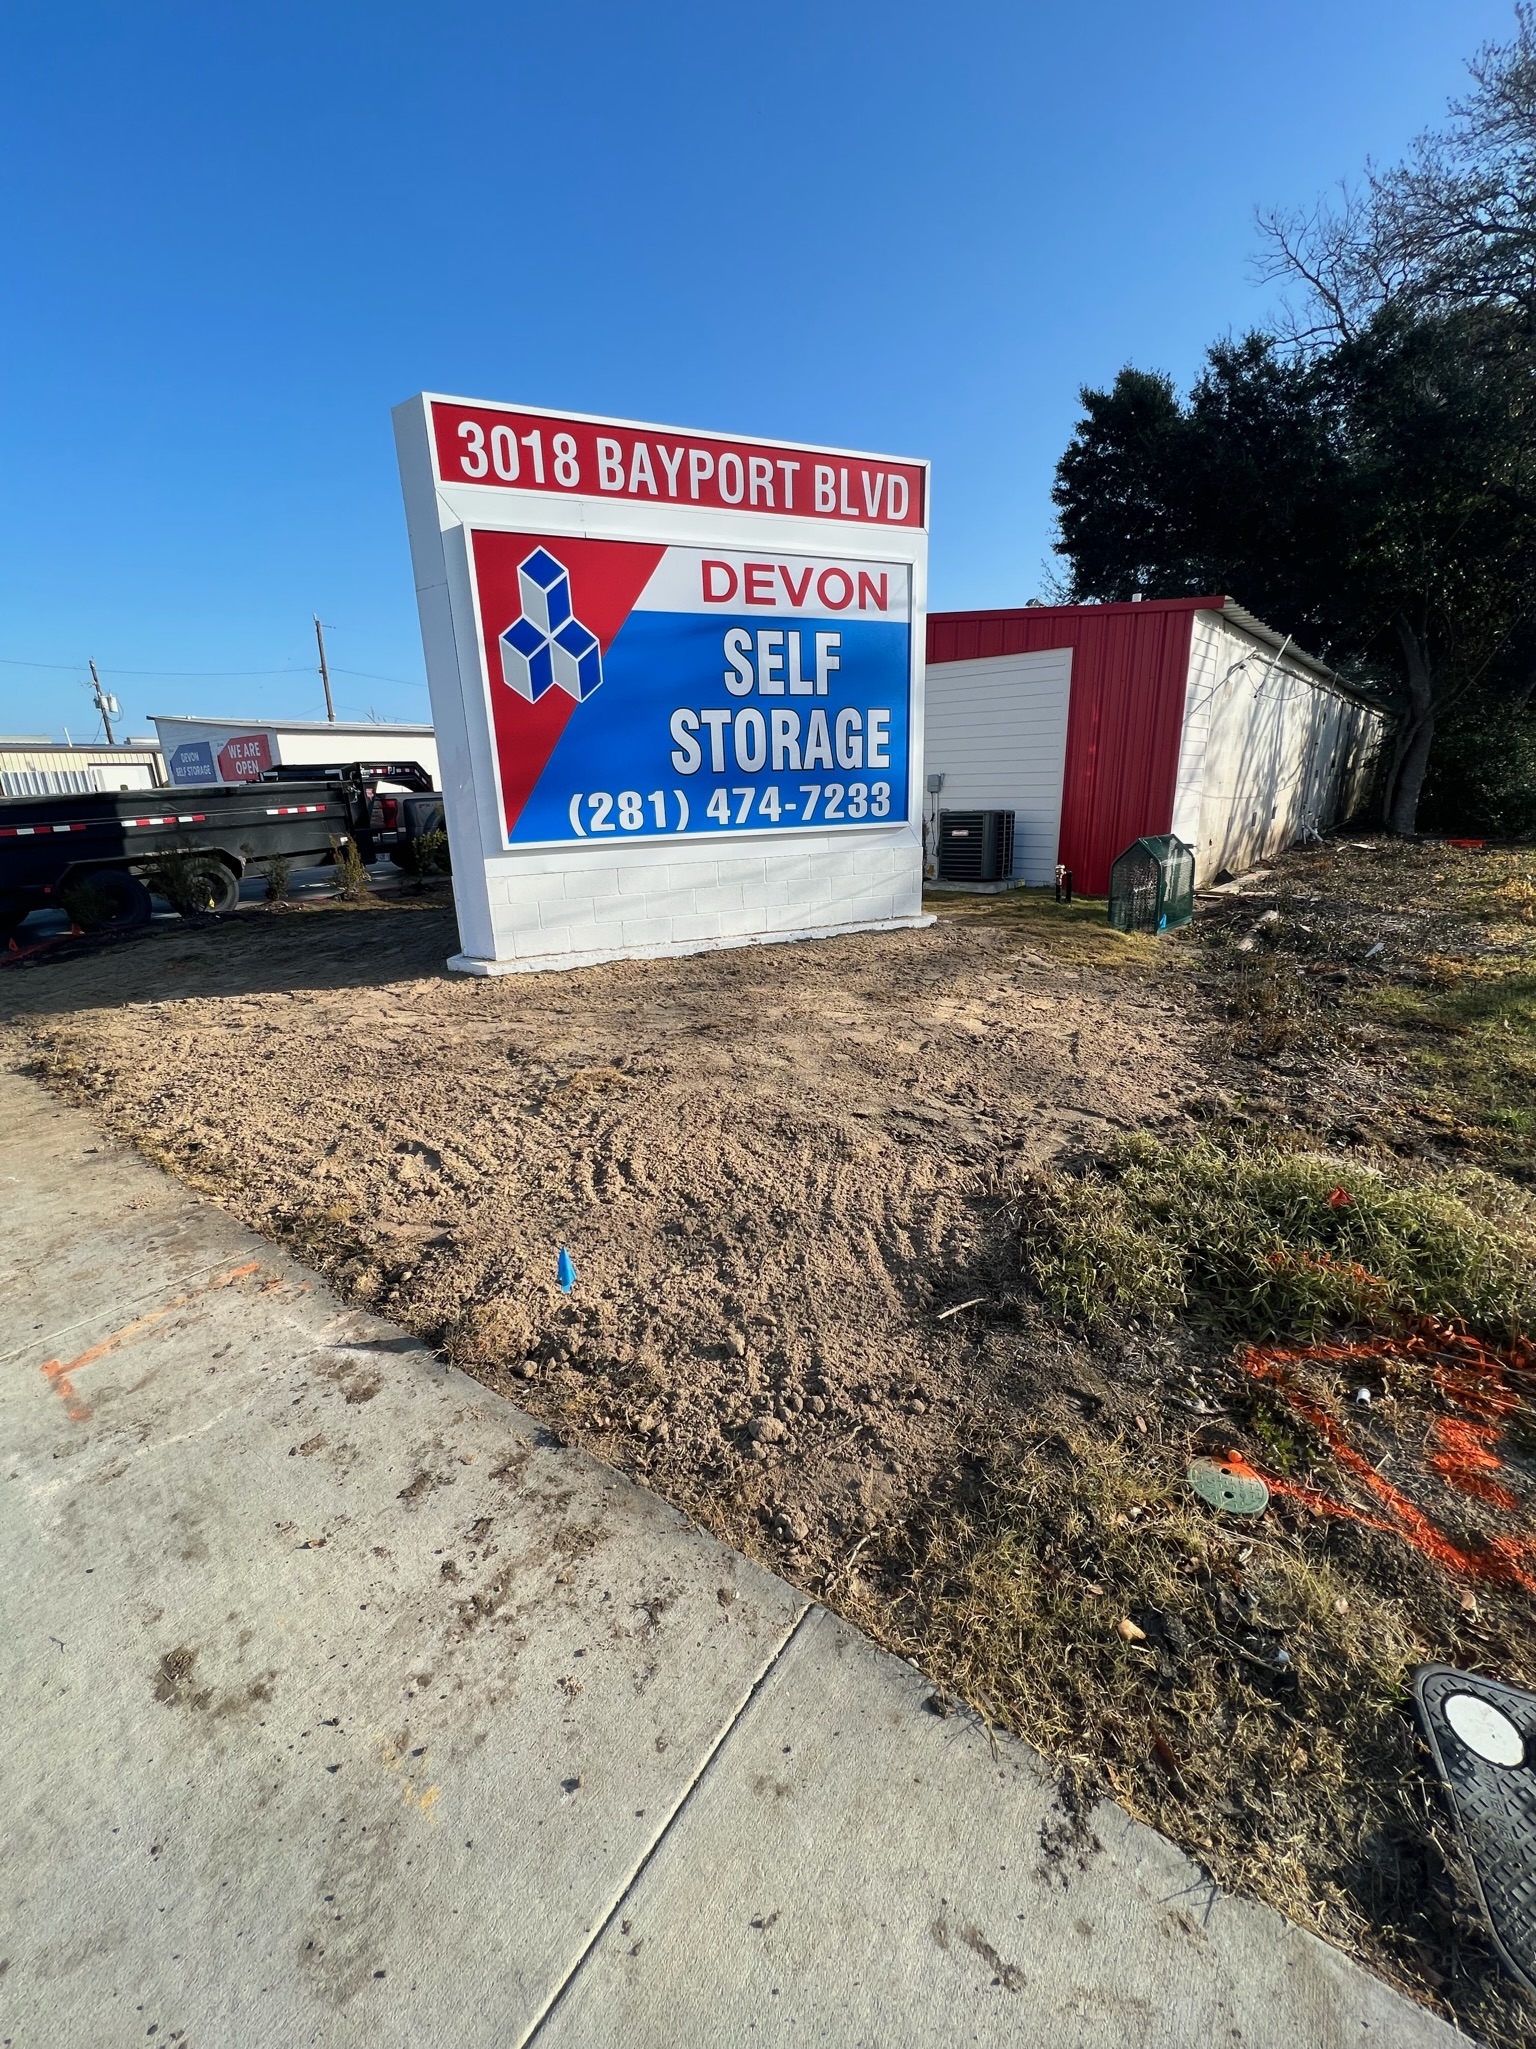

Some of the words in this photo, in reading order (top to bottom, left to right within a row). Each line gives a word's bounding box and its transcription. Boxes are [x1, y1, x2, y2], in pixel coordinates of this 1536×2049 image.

[458, 421, 580, 488] 3018
[596, 437, 800, 509] BAYPORT
[814, 465, 910, 520] BLVD
[701, 560, 888, 612] DEVON
[723, 627, 842, 697] SELF
[180, 751, 200, 763] DEVON
[227, 744, 242, 759] WE
[244, 742, 261, 757] ARE
[235, 760, 260, 775] OPEN
[669, 707, 891, 776] STORAGE
[175, 767, 186, 777] SELF
[187, 764, 211, 776] STORAGE
[568, 789, 690, 837] (281)
[706, 781, 891, 825] 474-7233
